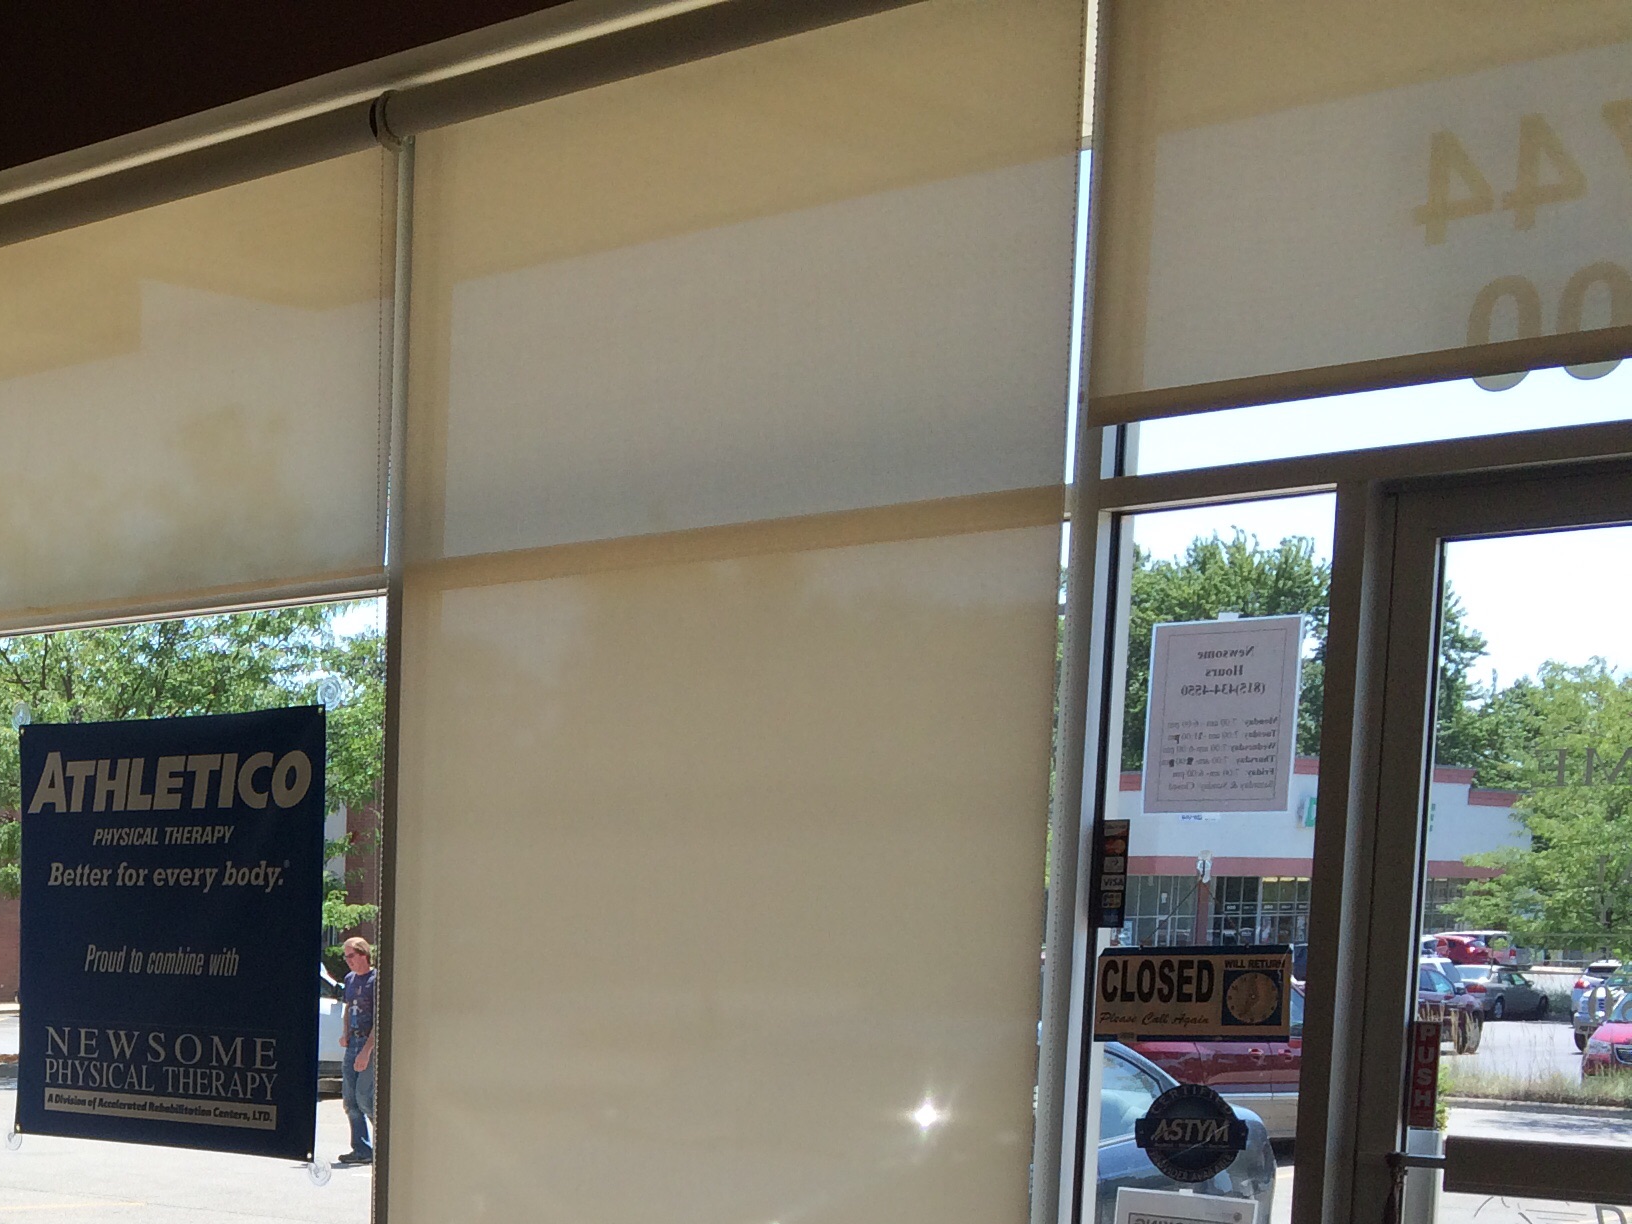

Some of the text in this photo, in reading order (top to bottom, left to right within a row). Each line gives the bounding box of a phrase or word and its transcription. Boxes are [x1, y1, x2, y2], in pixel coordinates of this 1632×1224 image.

[27, 749, 313, 814] ATHLETICO
[93, 825, 235, 846] PHYSICAL THERAPY
[48, 862, 110, 887] Better
[117, 861, 148, 886] for
[153, 864, 218, 894] every
[84, 944, 240, 977] Proud to combine with
[1102, 959, 1286, 1003] CLOSED WILL RETURN
[1099, 1011, 1209, 1027] Please Call Again
[46, 1026, 278, 1070] NEWSOME
[44, 1057, 278, 1101] PHYSICAL THERAPY
[1413, 1023, 1436, 1108] PUSH
[47, 1094, 273, 1122] A Division of Accelerated Rehabilitation Centers, LTD.
[1151, 1118, 1230, 1142] ASTYM
